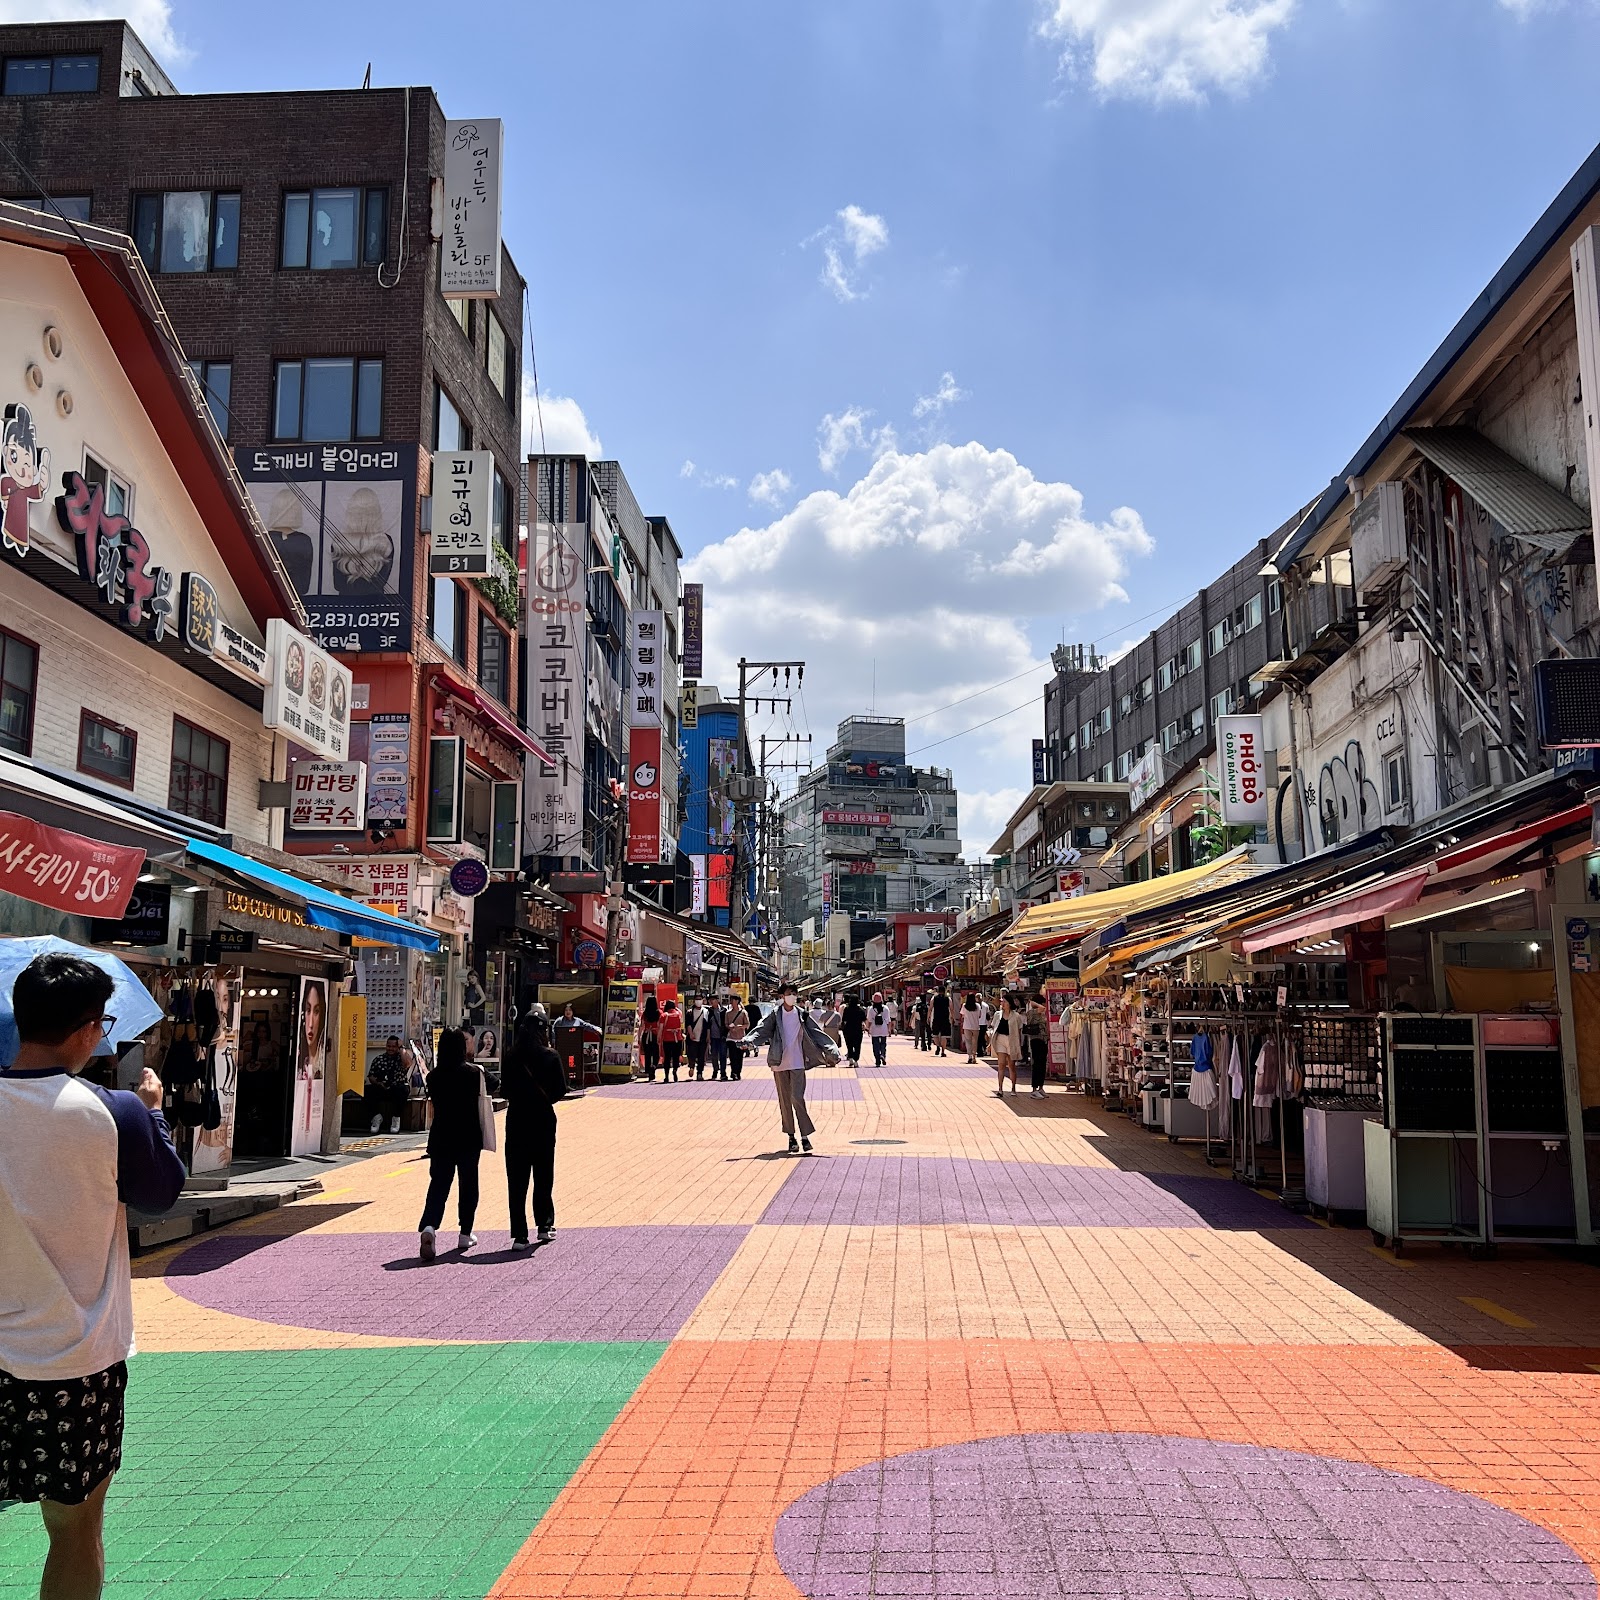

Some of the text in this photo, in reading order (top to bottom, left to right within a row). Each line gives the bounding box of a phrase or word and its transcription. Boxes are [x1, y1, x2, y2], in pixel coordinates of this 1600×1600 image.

[450, 196, 472, 266] 바이올린
[474, 255, 491, 266] 5F
[252, 446, 399, 473] 도깨비 붙임머리
[449, 460, 473, 527] 피규어
[435, 532, 484, 549] 프렌즈
[449, 557, 469, 571] B1
[687, 597, 699, 642] 더하우스
[379, 635, 397, 648] 3F
[637, 622, 656, 714] 힐링카페
[683, 690, 697, 722] 사진
[1556, 748, 1577, 768] bar
[295, 774, 358, 793] 마라탕
[1241, 777, 1265, 804] BÒ
[544, 793, 564, 808] 홍대
[292, 806, 356, 825] 쌀국수
[530, 812, 577, 826] 메인거리점
[542, 834, 567, 852] 2F
[367, 863, 409, 879] 전문점
[74, 865, 122, 903] 50%
[220, 934, 244, 943] BAG
[1570, 925, 1586, 934] ADT
[372, 951, 401, 966] 1+1
